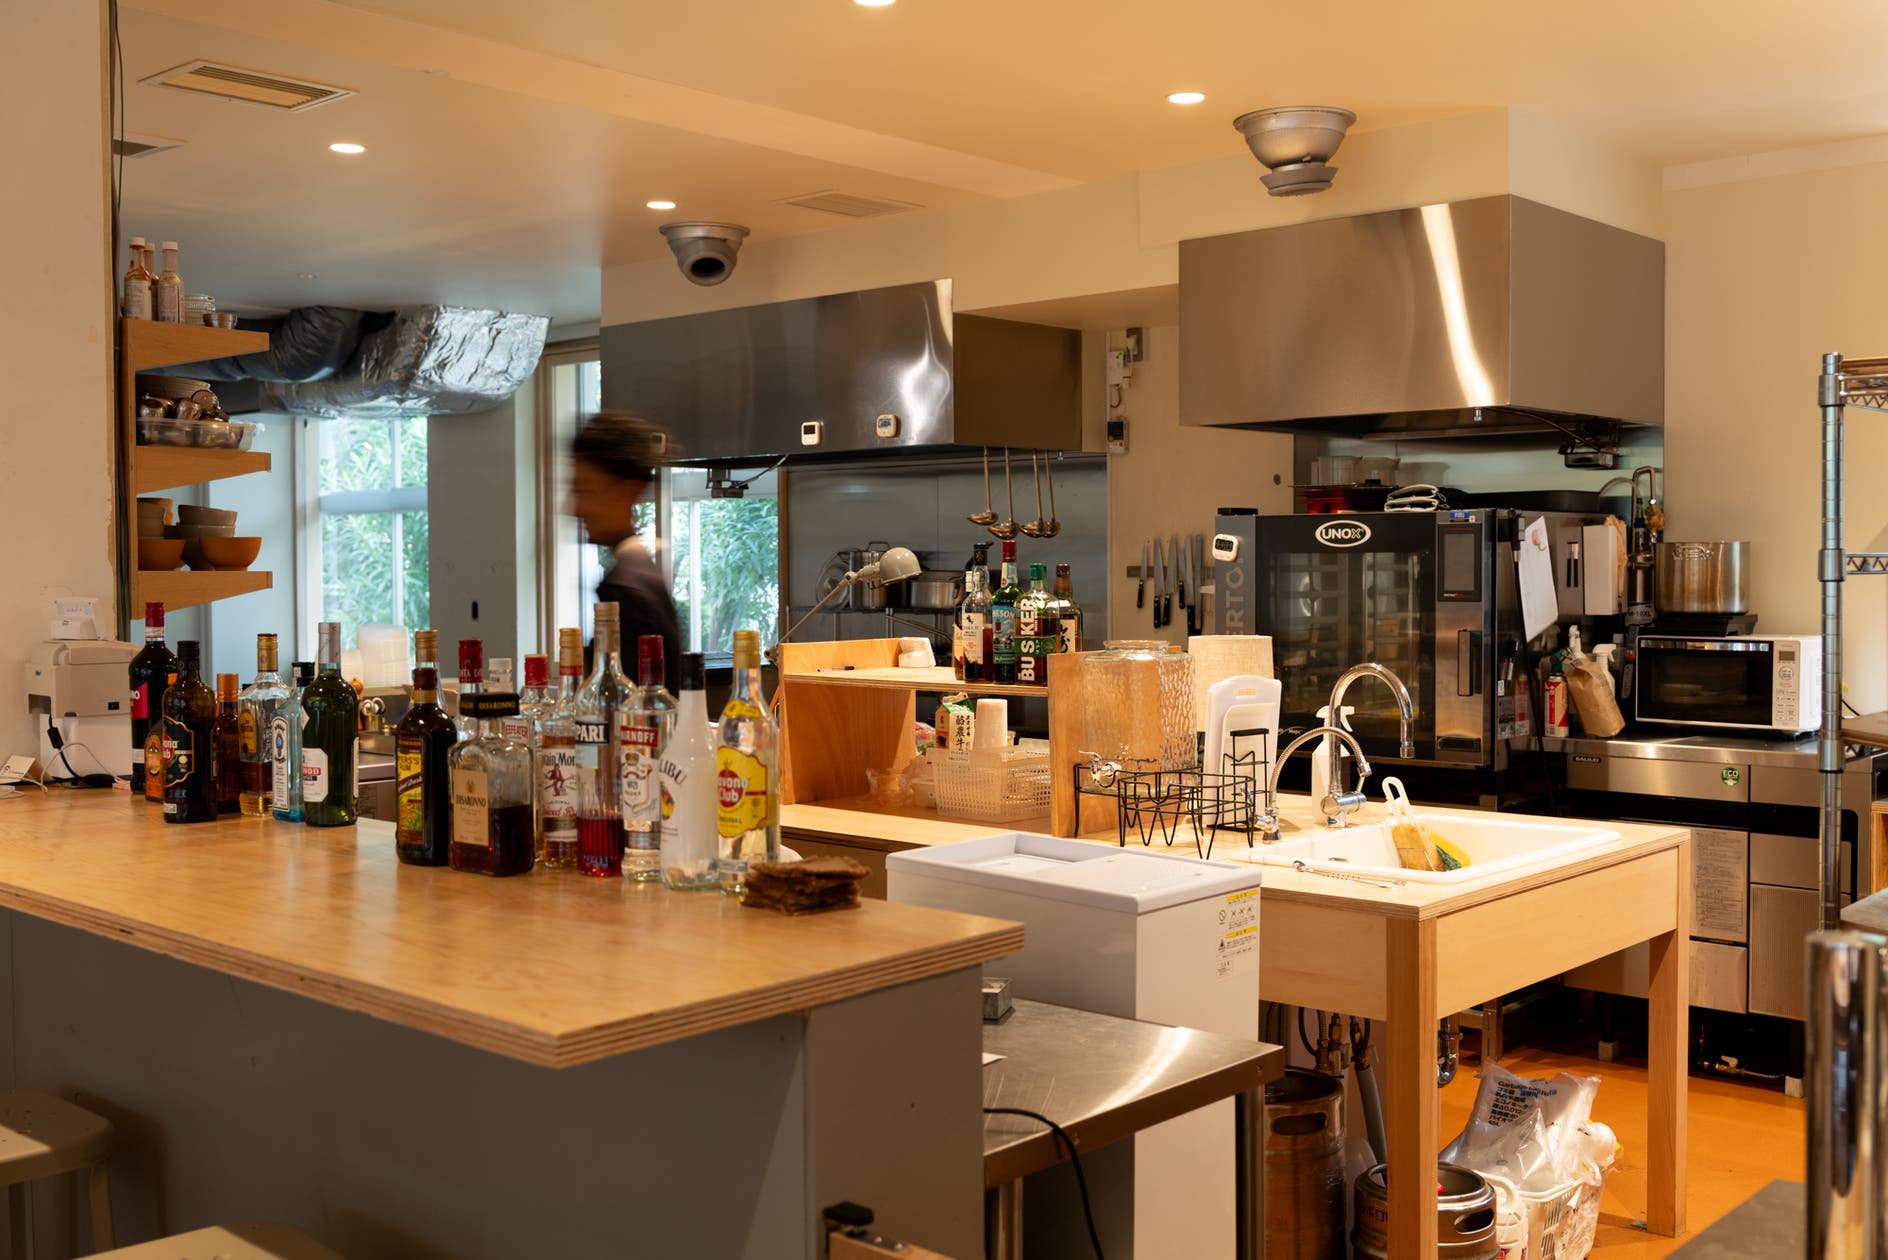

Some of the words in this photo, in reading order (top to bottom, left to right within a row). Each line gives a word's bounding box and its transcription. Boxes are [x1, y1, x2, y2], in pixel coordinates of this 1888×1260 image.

[1321, 527, 1362, 540] UNOX
[1020, 598, 1036, 681] BUSKER
[1723, 769, 1739, 778] ECO
